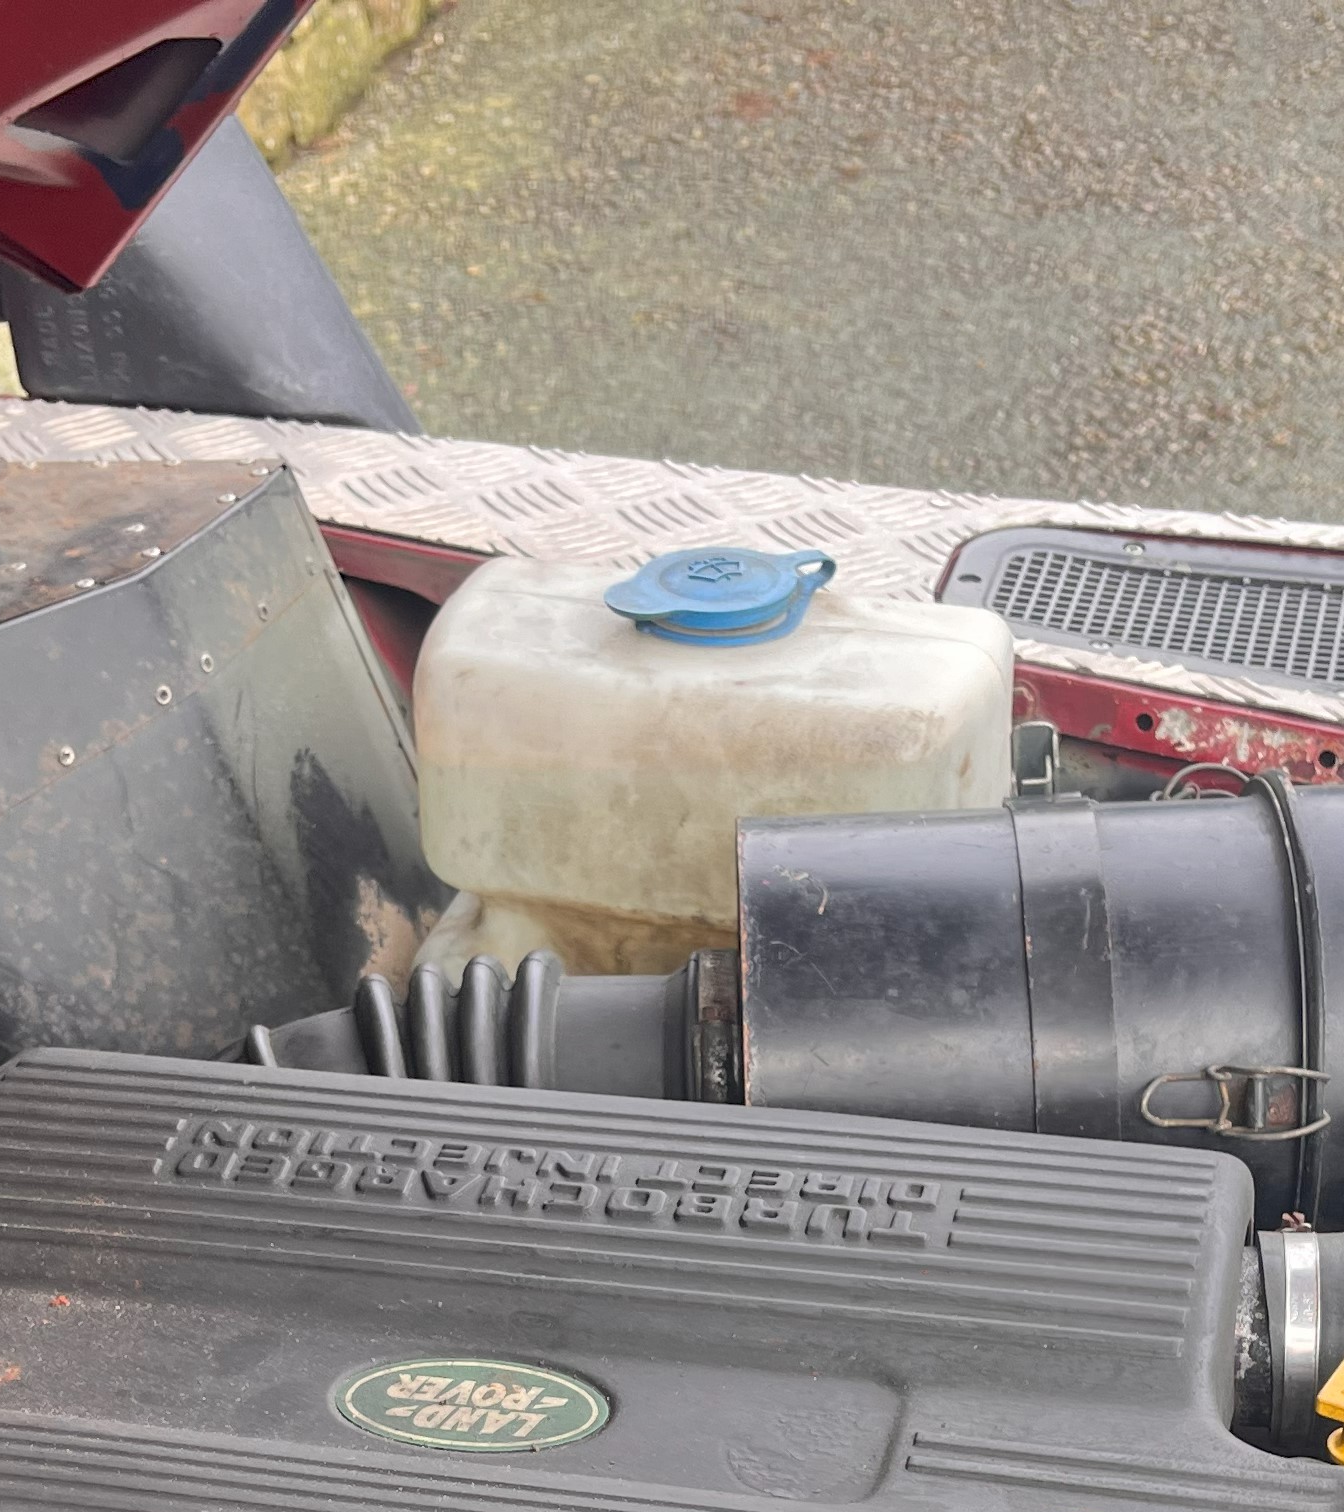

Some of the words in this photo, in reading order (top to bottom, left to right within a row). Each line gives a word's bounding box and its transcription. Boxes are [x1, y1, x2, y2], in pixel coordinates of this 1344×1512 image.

[190, 1119, 623, 1183] INJECTION
[175, 1147, 928, 1247] TURBOCHARGED
[636, 1158, 941, 1209] DIRECT
[386, 1373, 546, 1412] ROVER
[413, 1404, 548, 1438] LAND
